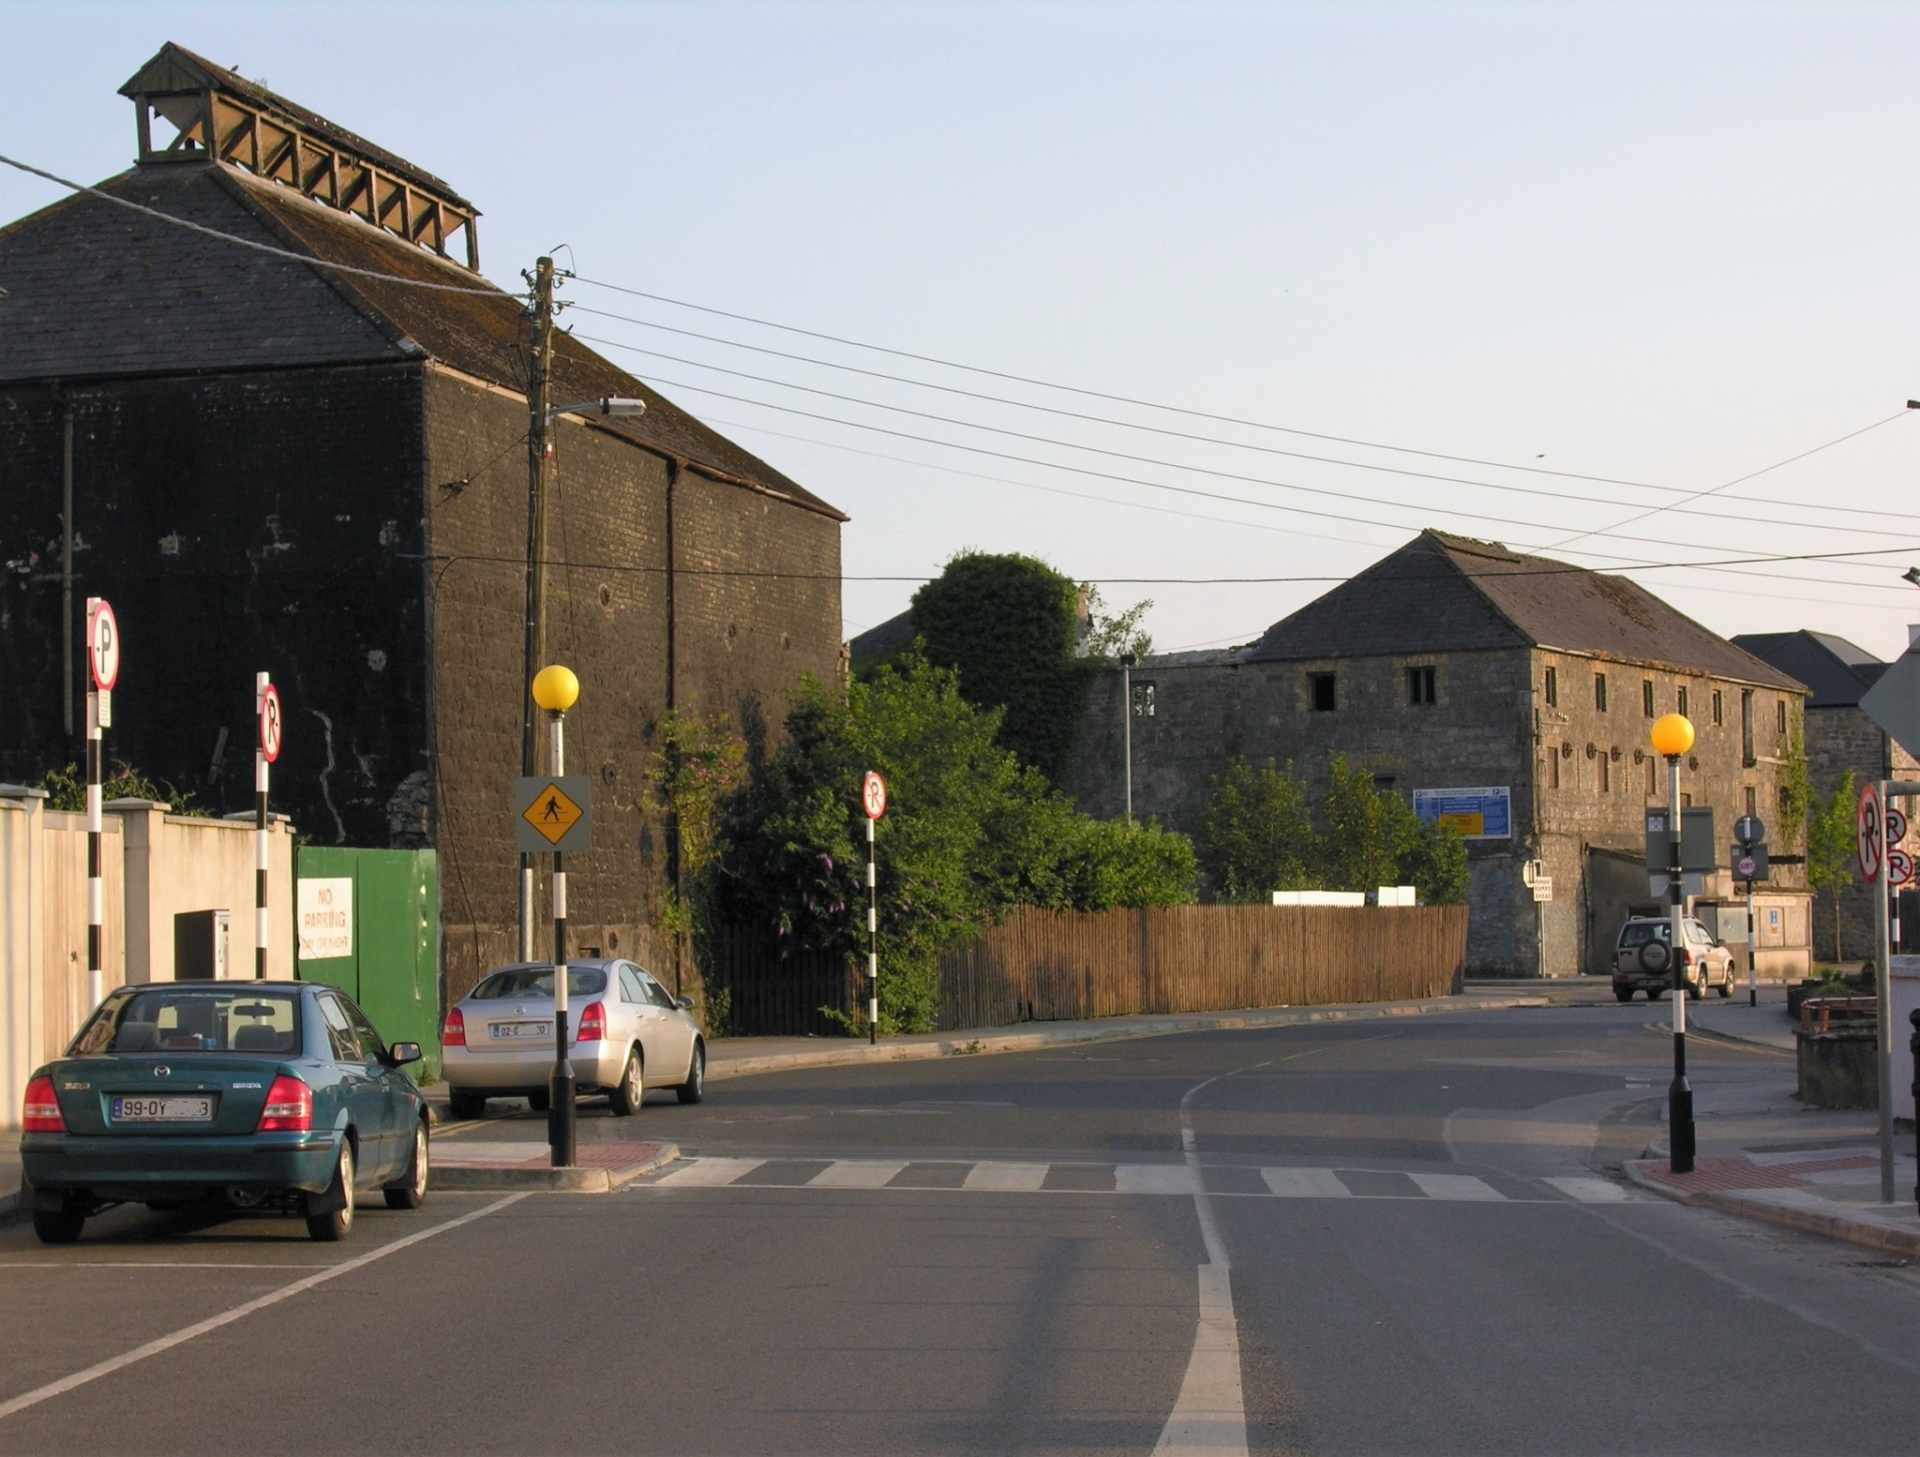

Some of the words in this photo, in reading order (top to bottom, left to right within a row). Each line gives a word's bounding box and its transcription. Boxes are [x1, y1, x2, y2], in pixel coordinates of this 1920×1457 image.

[101, 619, 111, 674] P
[318, 888, 332, 905] NO
[305, 911, 346, 929] PARKING
